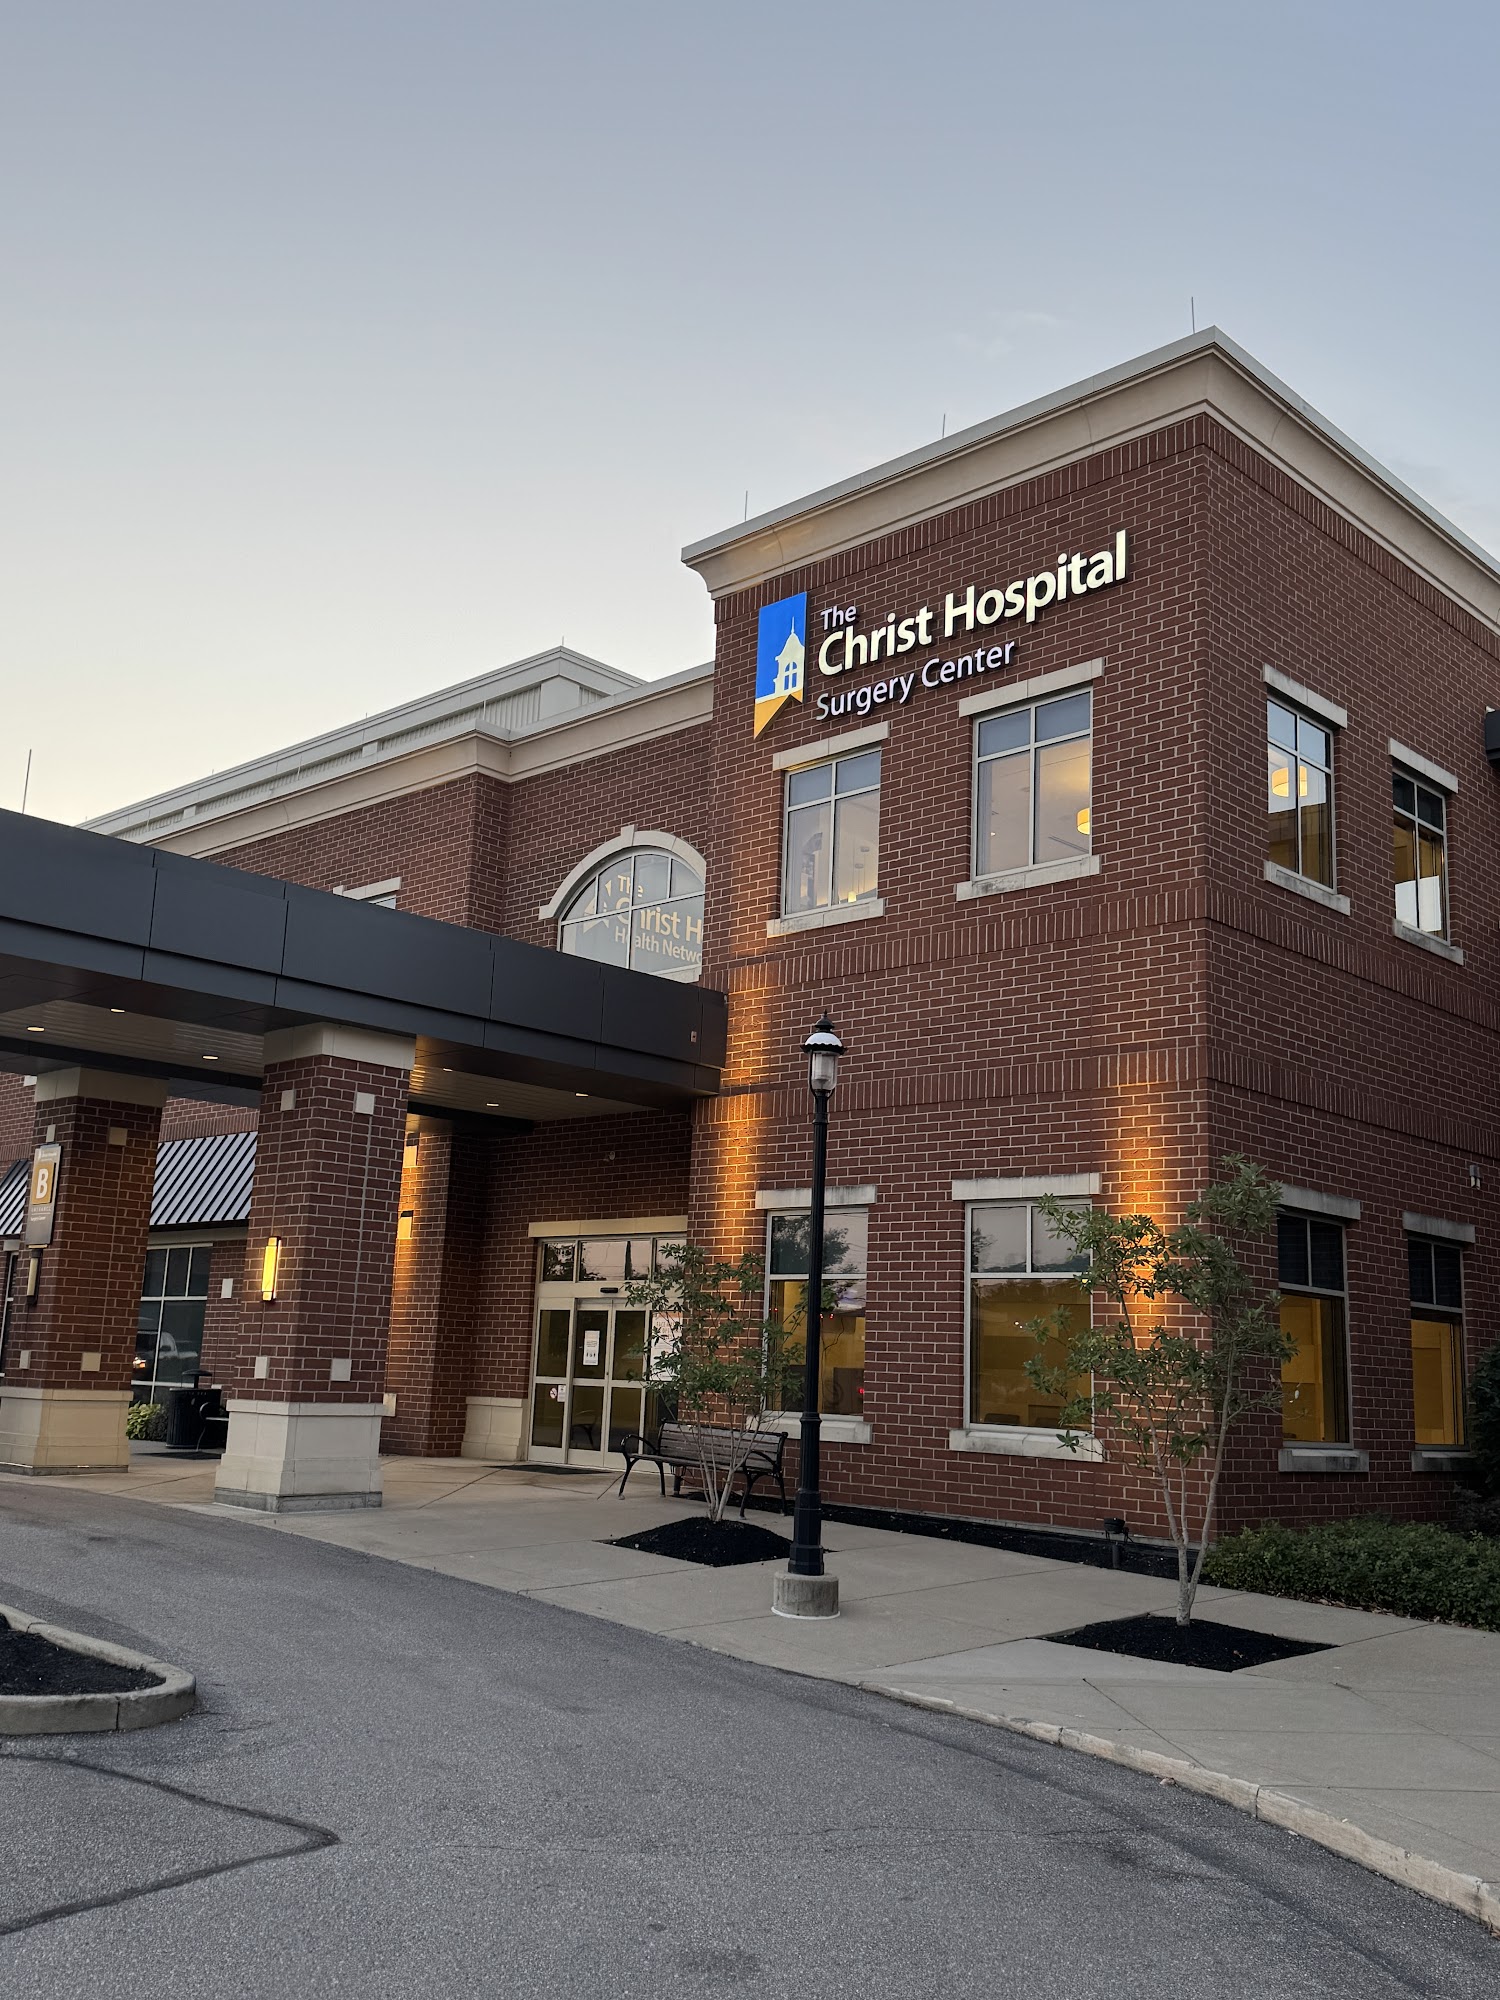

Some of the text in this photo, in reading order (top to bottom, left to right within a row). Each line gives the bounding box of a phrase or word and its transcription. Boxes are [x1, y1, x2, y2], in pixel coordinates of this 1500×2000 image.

[818, 529, 1128, 677] Christ Hospital
[820, 604, 858, 632] The
[815, 640, 1016, 722] Surgery Center
[615, 926, 659, 952] Halth
[35, 1168, 49, 1199] B
